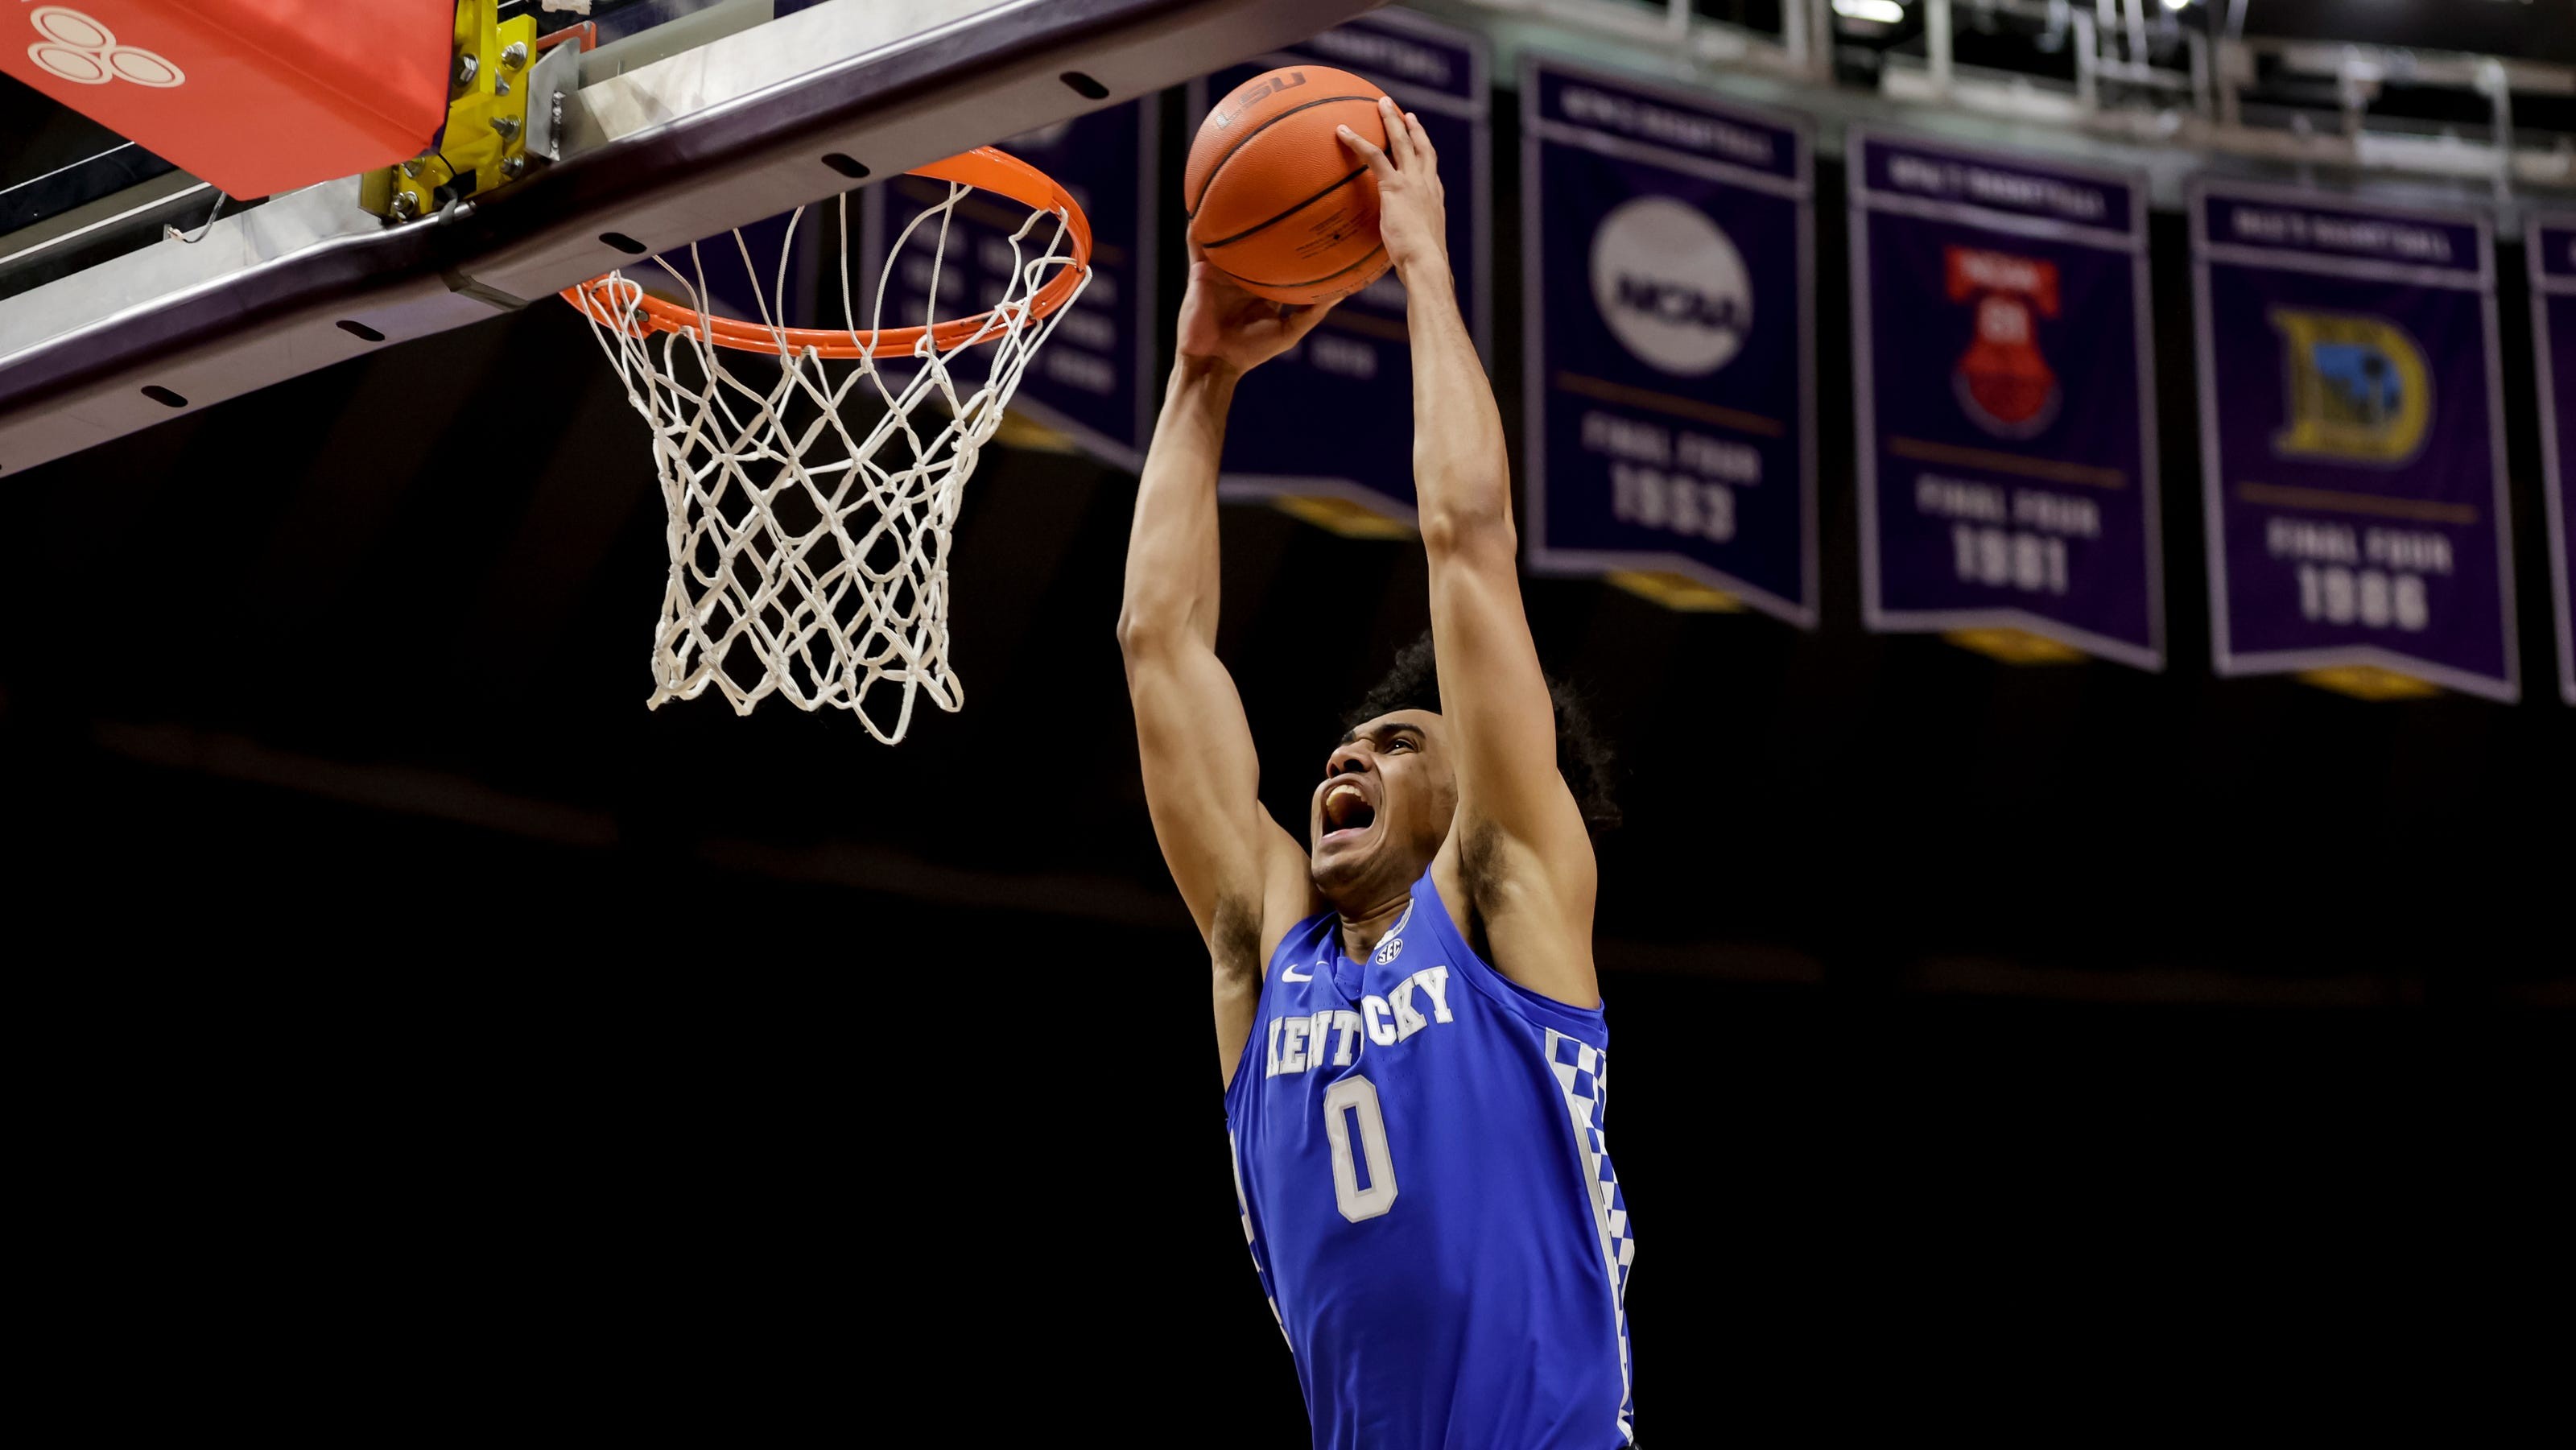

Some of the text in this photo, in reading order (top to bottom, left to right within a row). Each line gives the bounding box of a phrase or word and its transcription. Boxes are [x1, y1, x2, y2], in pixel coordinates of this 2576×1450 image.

[1216, 72, 1306, 130] LSU
[1615, 271, 1748, 333] NCAA
[1582, 411, 1761, 485] FINAL FOUR
[1916, 473, 2101, 539] FINAL FOUR
[2266, 516, 2453, 576] FINAL FOUR
[1377, 940, 1402, 964] SEC
[1265, 965, 1454, 1080] KENTCKY
[1323, 1075, 1398, 1224] 0
